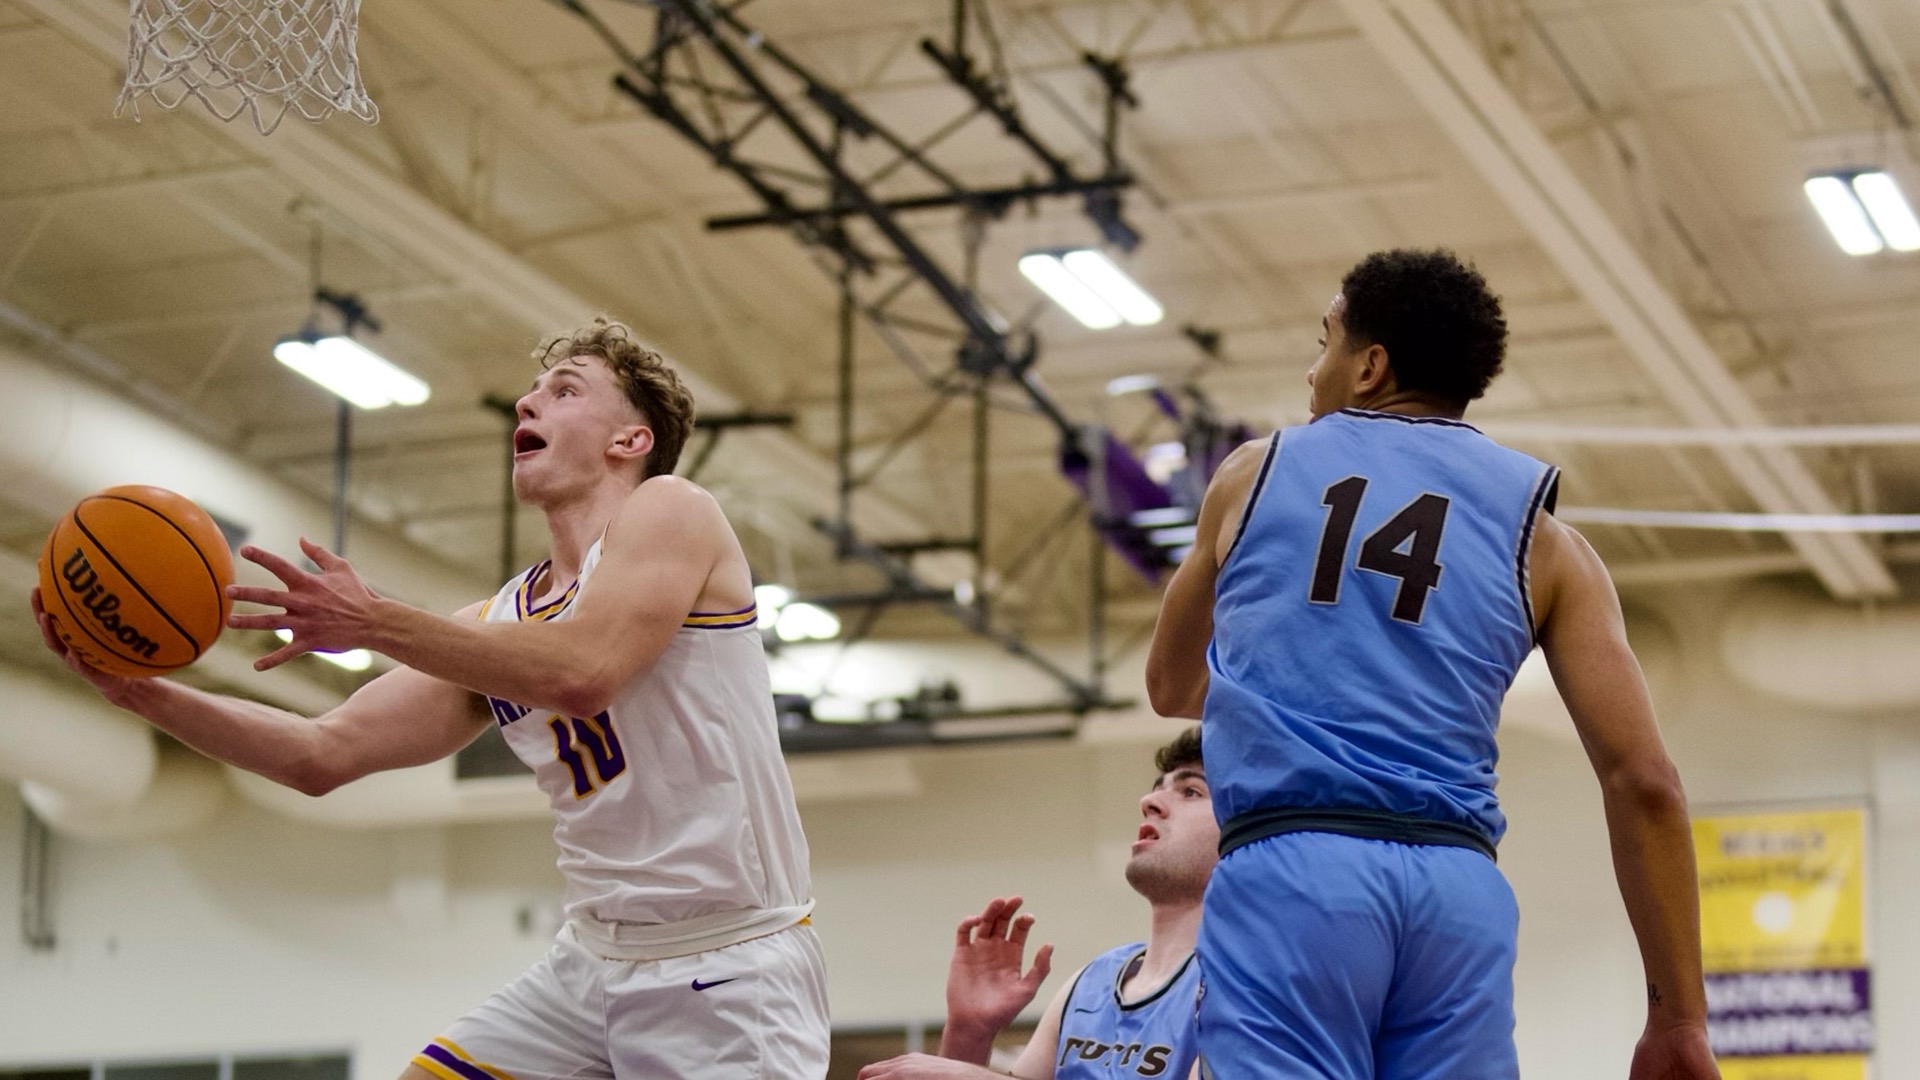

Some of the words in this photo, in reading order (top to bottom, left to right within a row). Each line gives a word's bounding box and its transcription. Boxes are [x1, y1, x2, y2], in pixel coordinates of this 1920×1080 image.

[62, 547, 160, 659] Wilson
[1308, 474, 1451, 626] 14
[547, 710, 627, 800] 10
